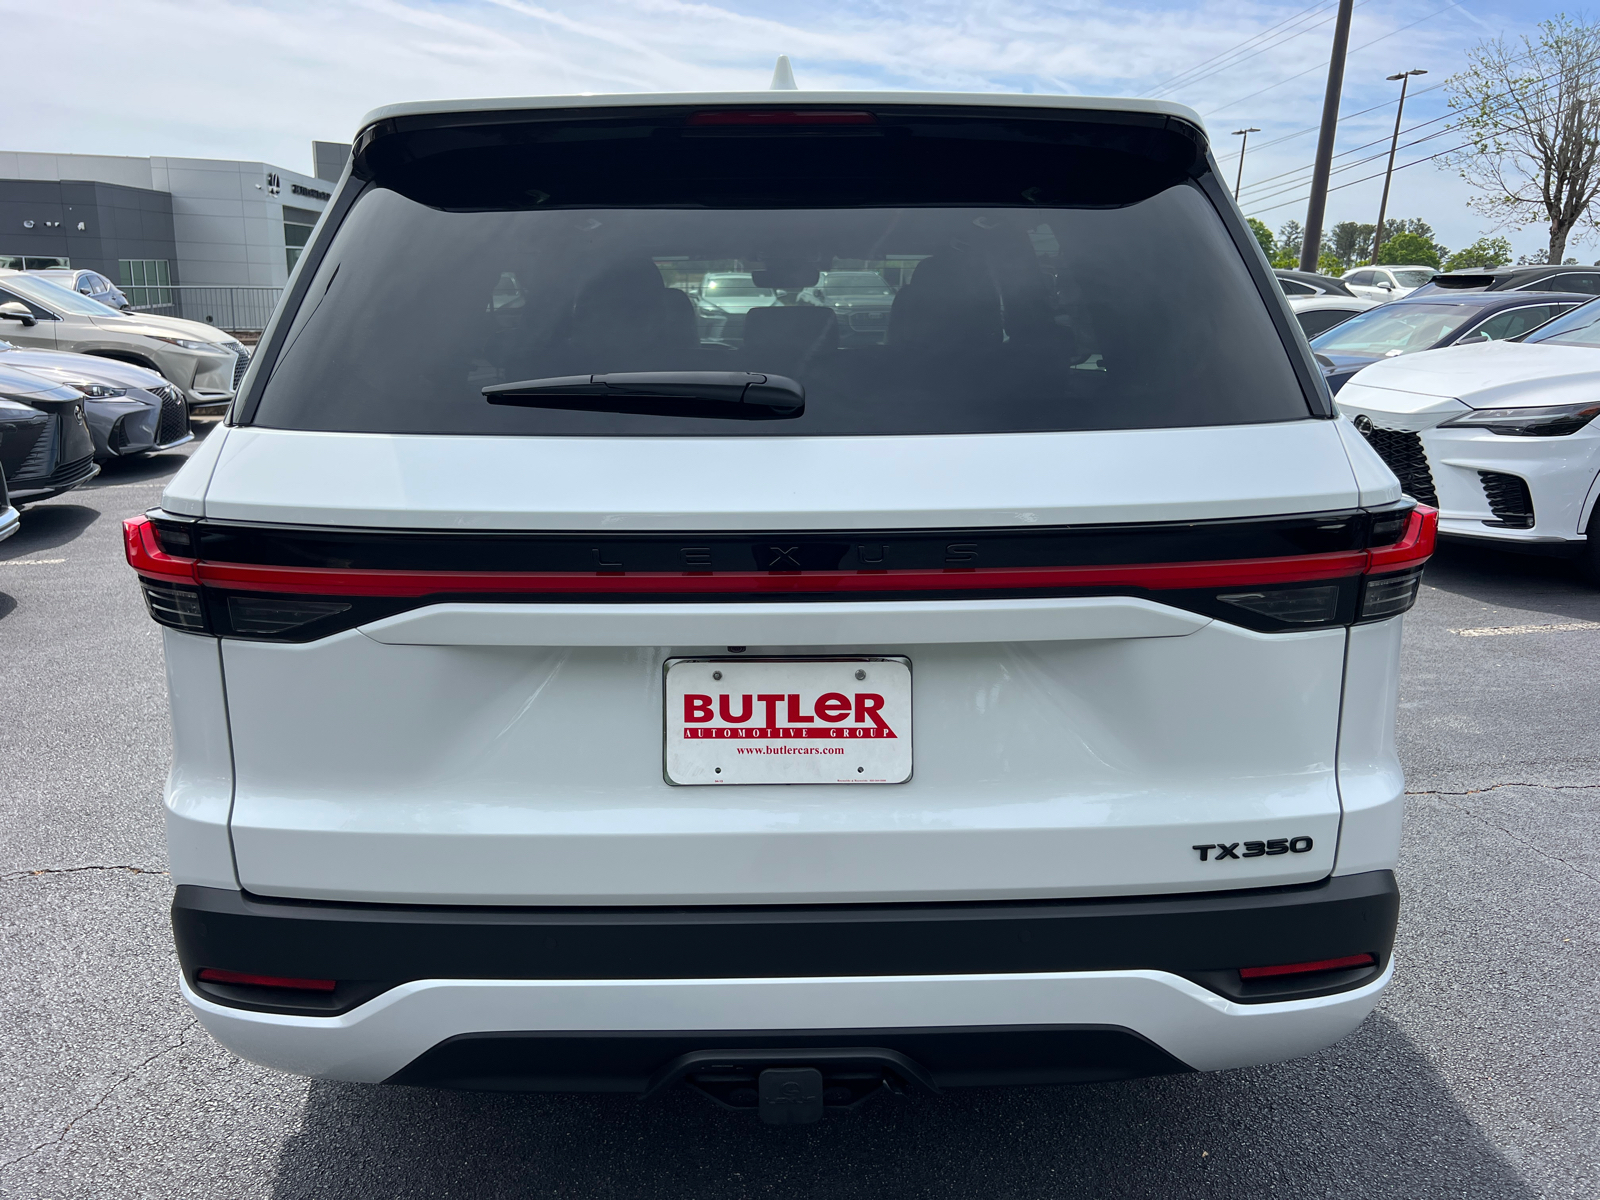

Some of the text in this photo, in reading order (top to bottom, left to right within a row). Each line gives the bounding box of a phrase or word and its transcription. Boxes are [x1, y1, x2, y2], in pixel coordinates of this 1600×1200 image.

[590, 542, 980, 567] LEXUS
[684, 727, 890, 738] AUTOMOTIVE GROUP
[736, 745, 845, 755] www.butlercars.com
